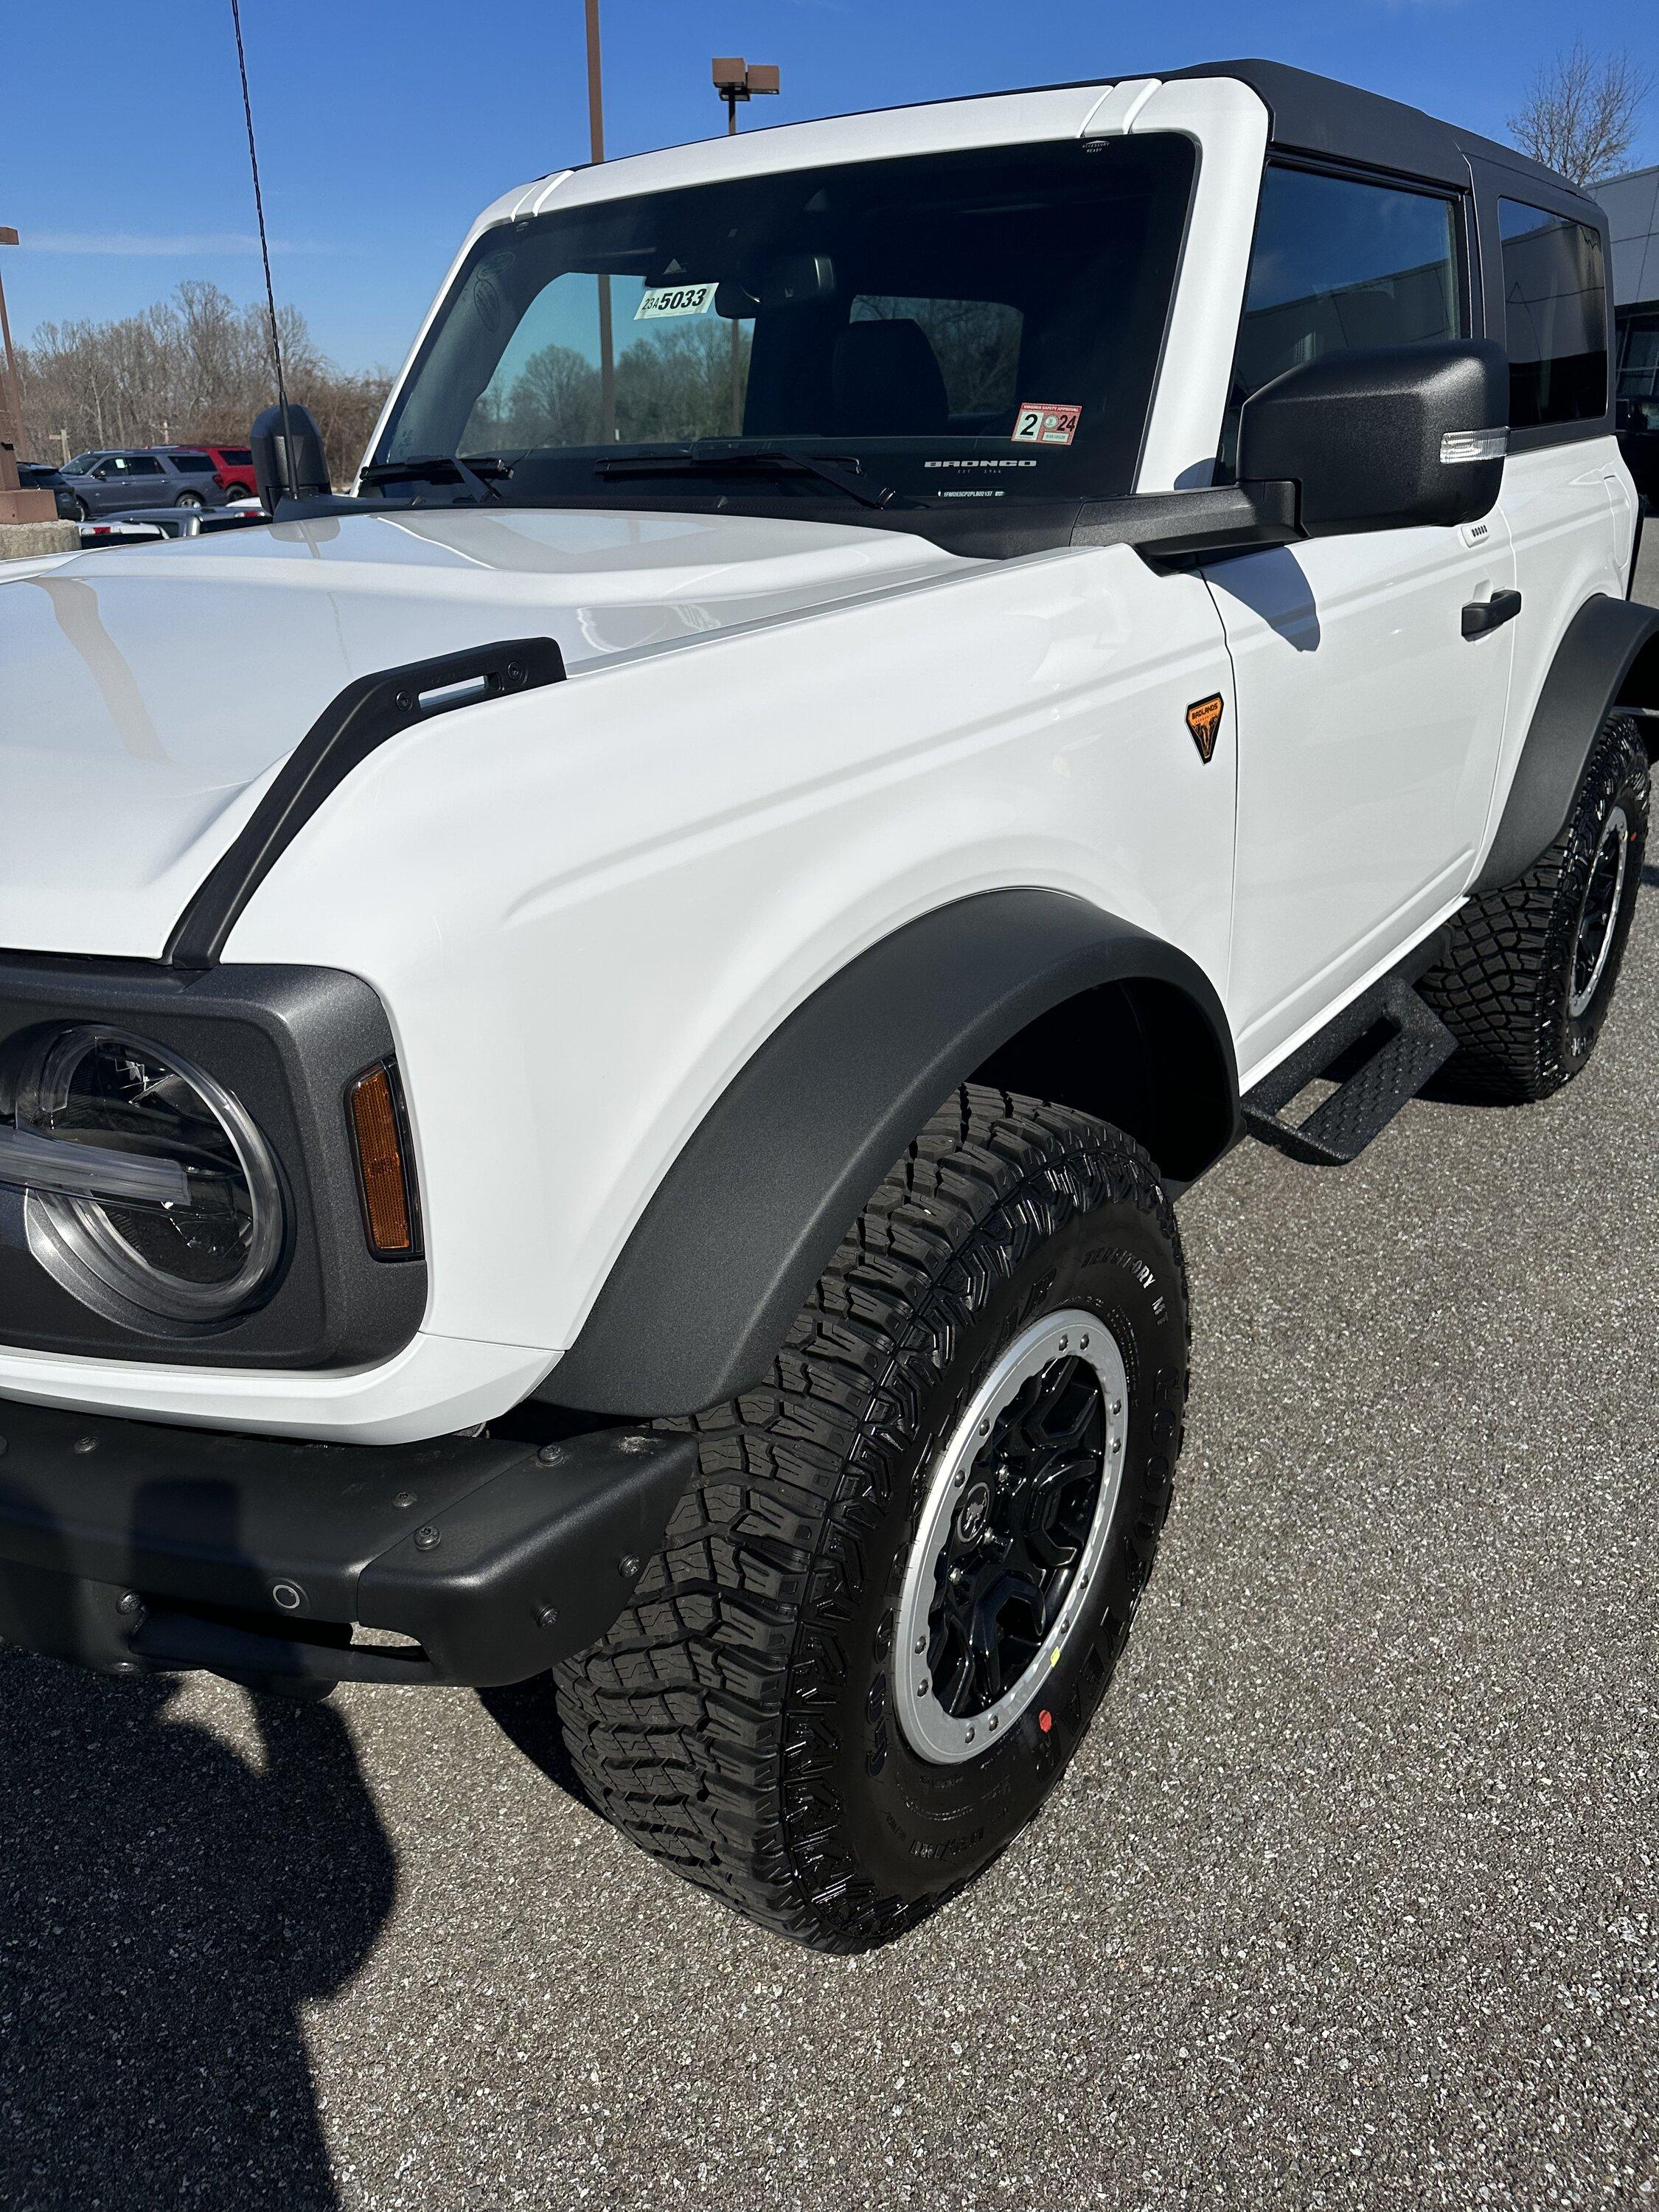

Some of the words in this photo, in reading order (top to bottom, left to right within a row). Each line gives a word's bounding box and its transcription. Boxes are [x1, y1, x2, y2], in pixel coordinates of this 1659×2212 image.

[1020, 414, 1037, 436] 2
[1057, 414, 1077, 432] 24
[924, 460, 1037, 468] BRONCO
[1192, 702, 1218, 720] BADLANDS
[1081, 1246, 1156, 1289] TERRITORY
[1151, 1295, 1169, 1326] MT
